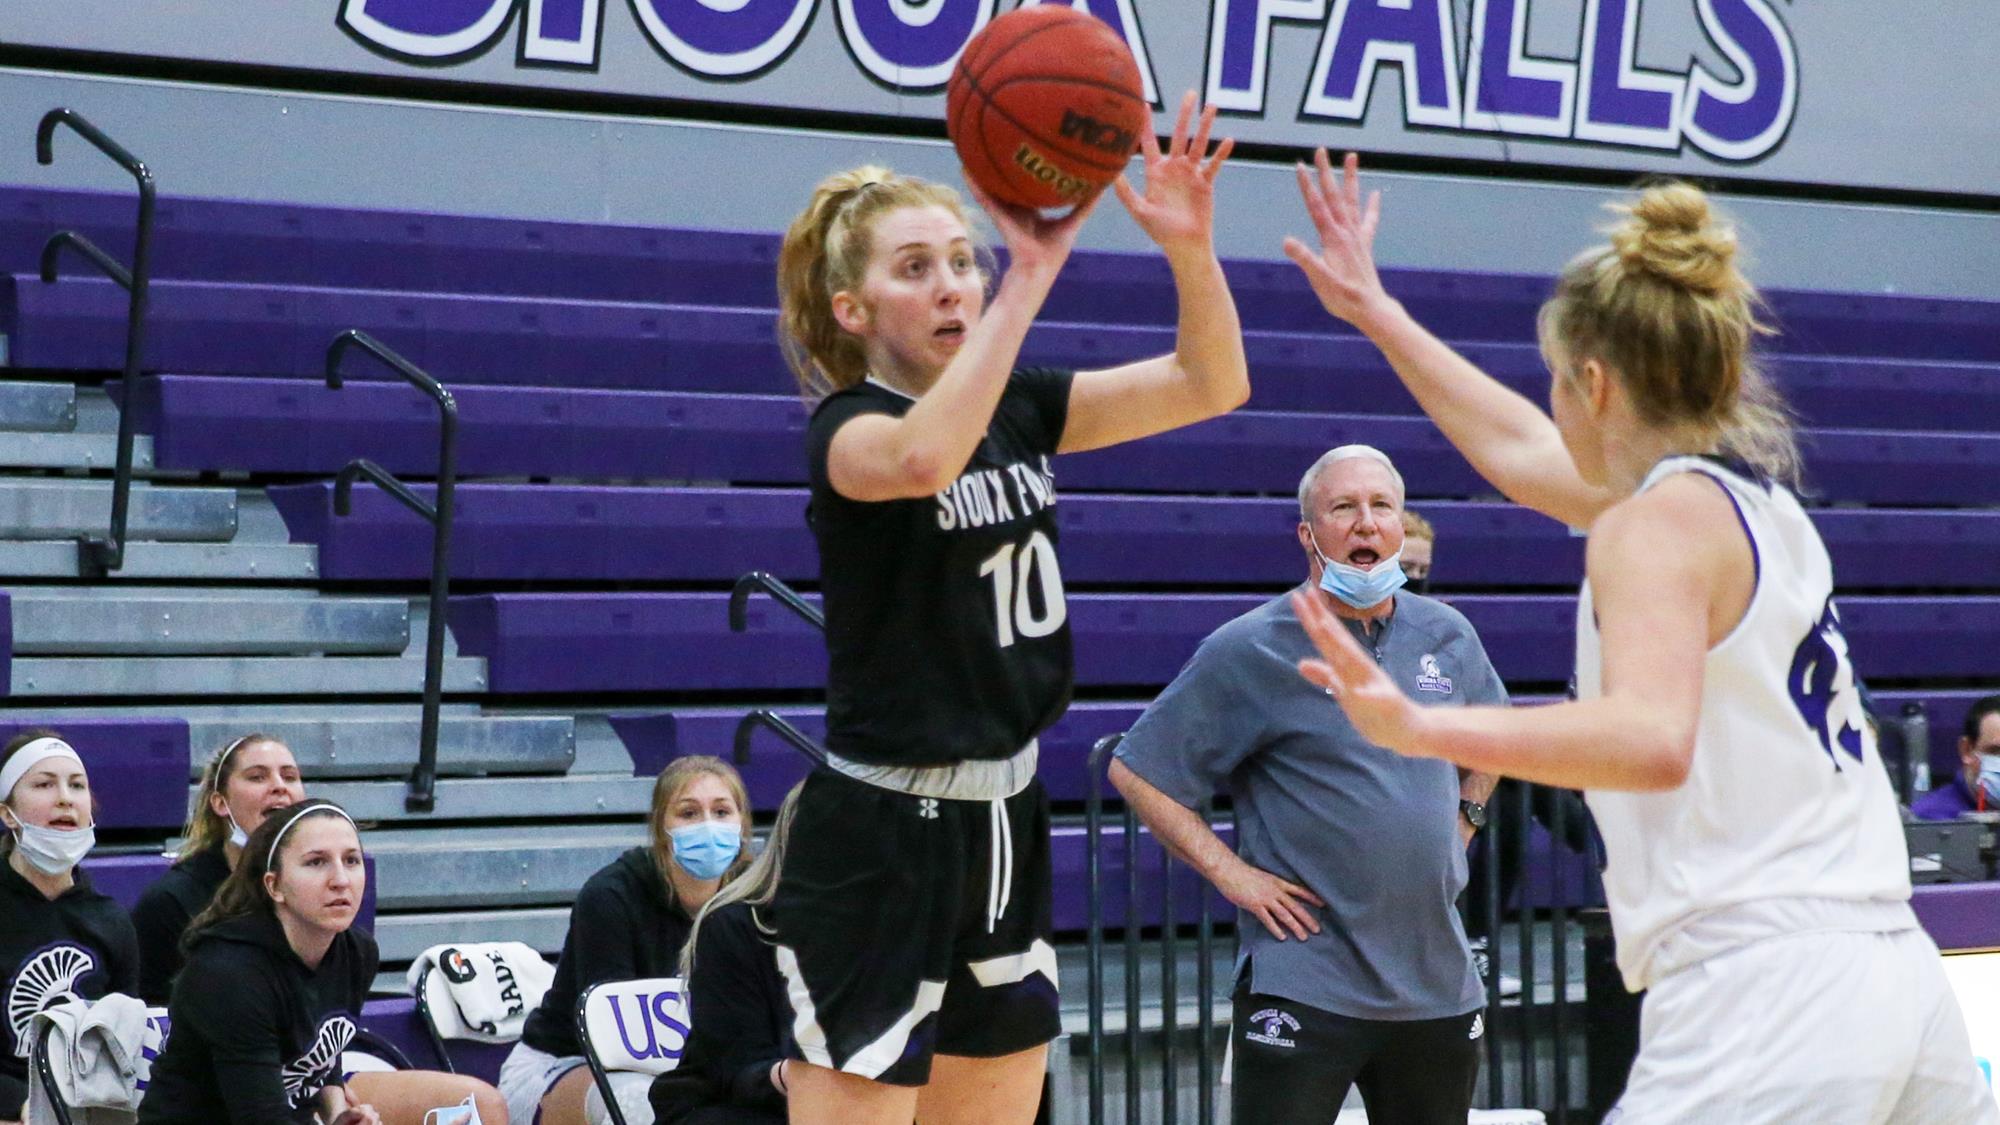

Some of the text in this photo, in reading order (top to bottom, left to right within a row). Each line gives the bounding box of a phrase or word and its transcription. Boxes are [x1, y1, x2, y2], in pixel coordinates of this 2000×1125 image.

[937, 469, 1014, 530] SIOUX
[978, 531, 1066, 648] 10
[605, 991, 692, 1060] US
